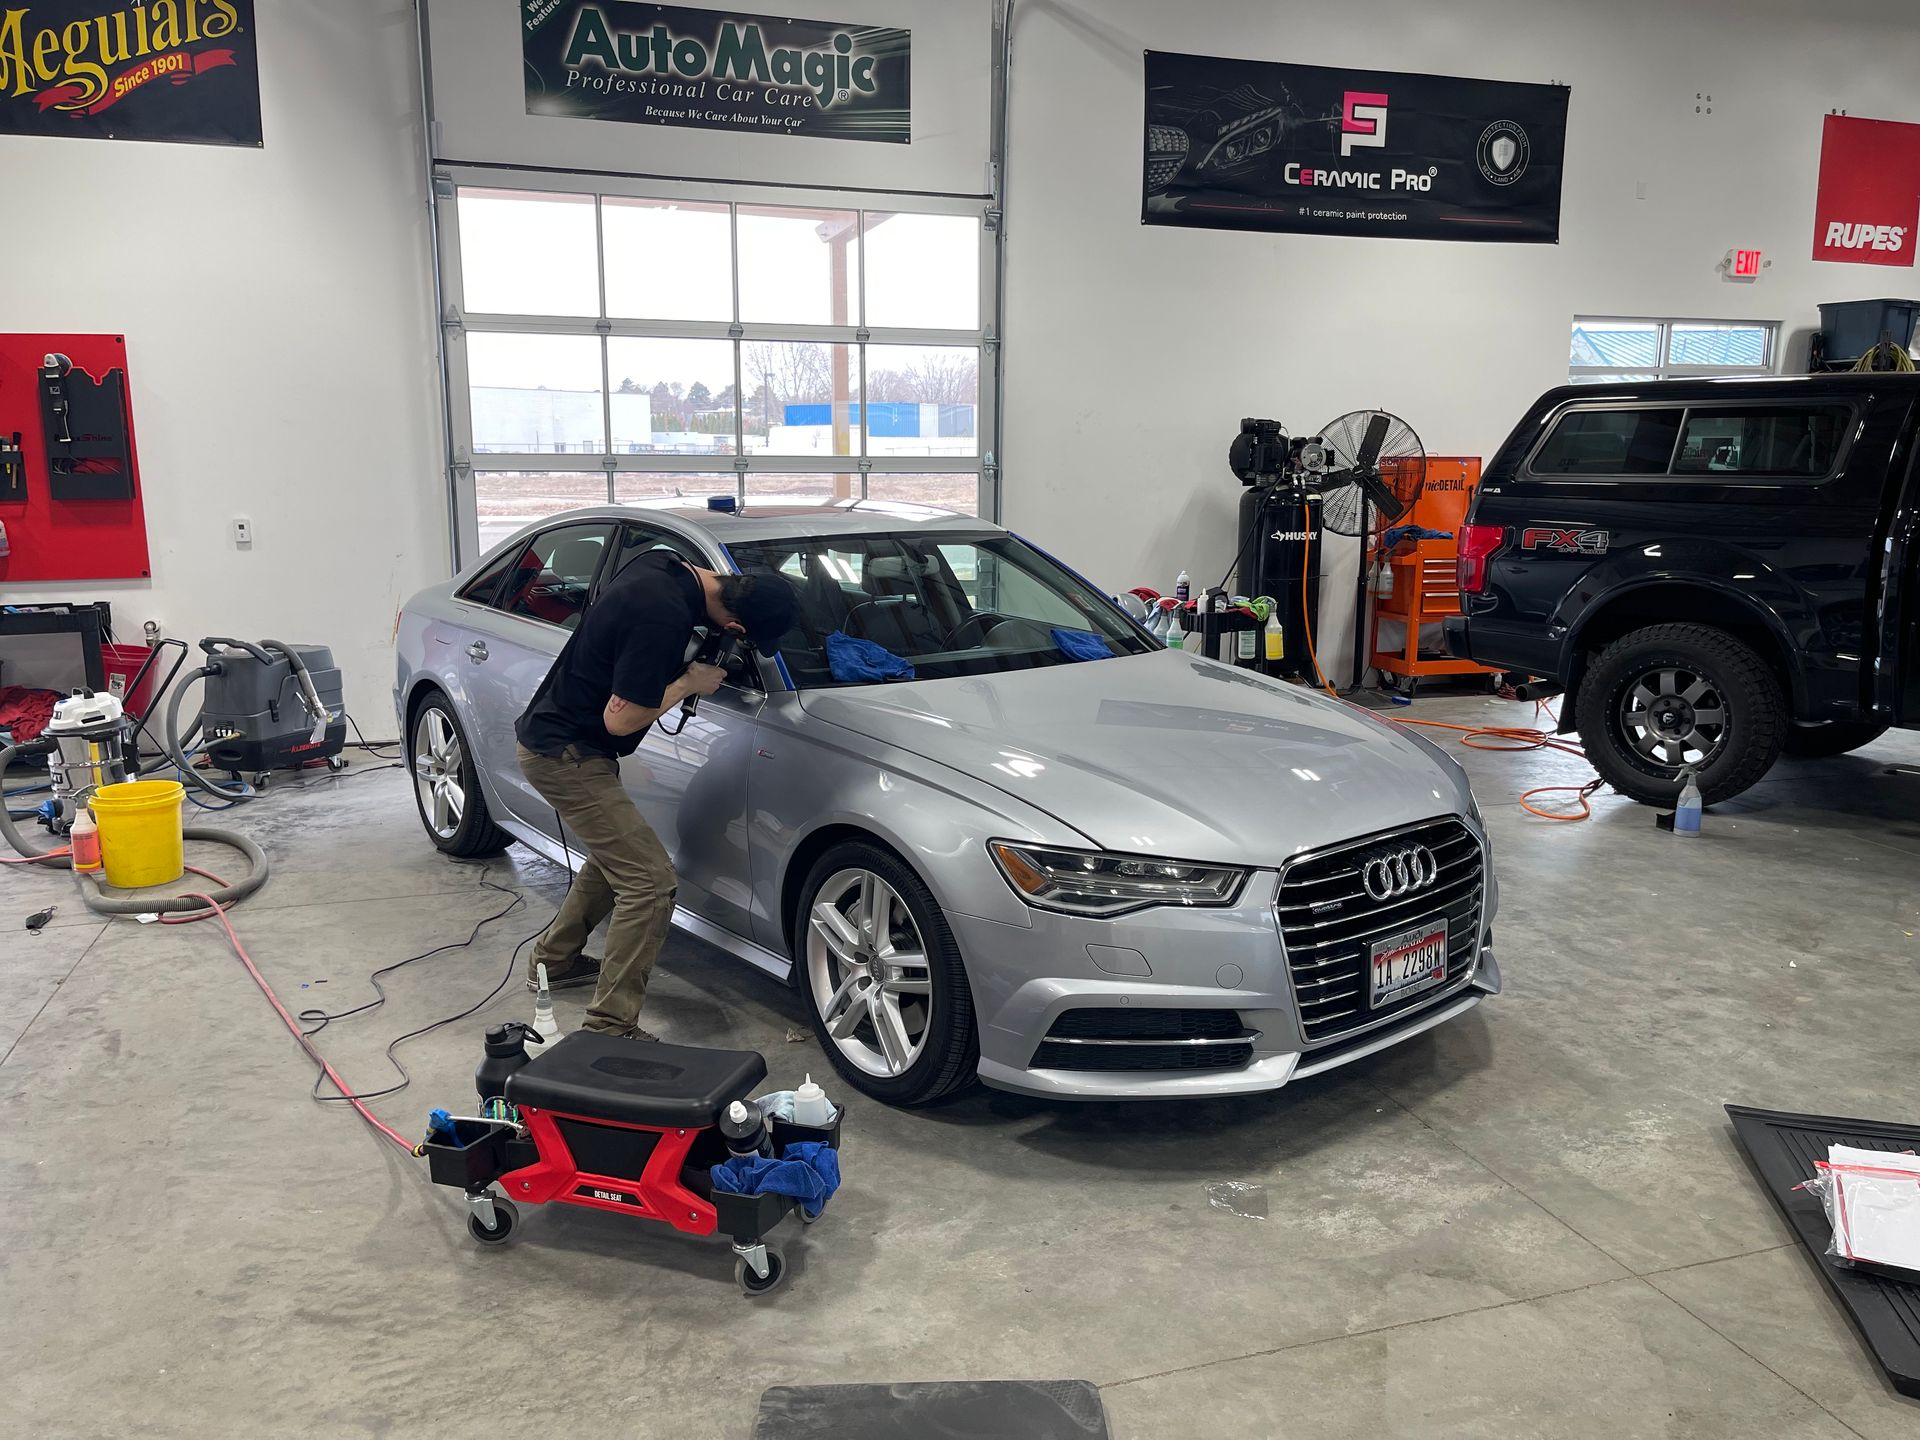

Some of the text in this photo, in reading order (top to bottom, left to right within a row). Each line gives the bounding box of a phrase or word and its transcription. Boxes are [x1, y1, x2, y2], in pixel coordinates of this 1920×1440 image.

[114, 54, 184, 98] Since 1901
[566, 70, 812, 108] Professional Car Care
[645, 106, 803, 127] Because We Care About Your Car
[1482, 123, 1527, 148] PROTECTION FROM
[1299, 208, 1407, 221] #1 ceramic paint protection
[1824, 222, 1903, 252] RUPES
[1735, 251, 1761, 275] EXIT
[1521, 527, 1609, 550] FX4
[1401, 930, 1424, 945] Audi
[1376, 957, 1393, 989] 1A
[594, 1190, 622, 1202] DETAIL SEAT
